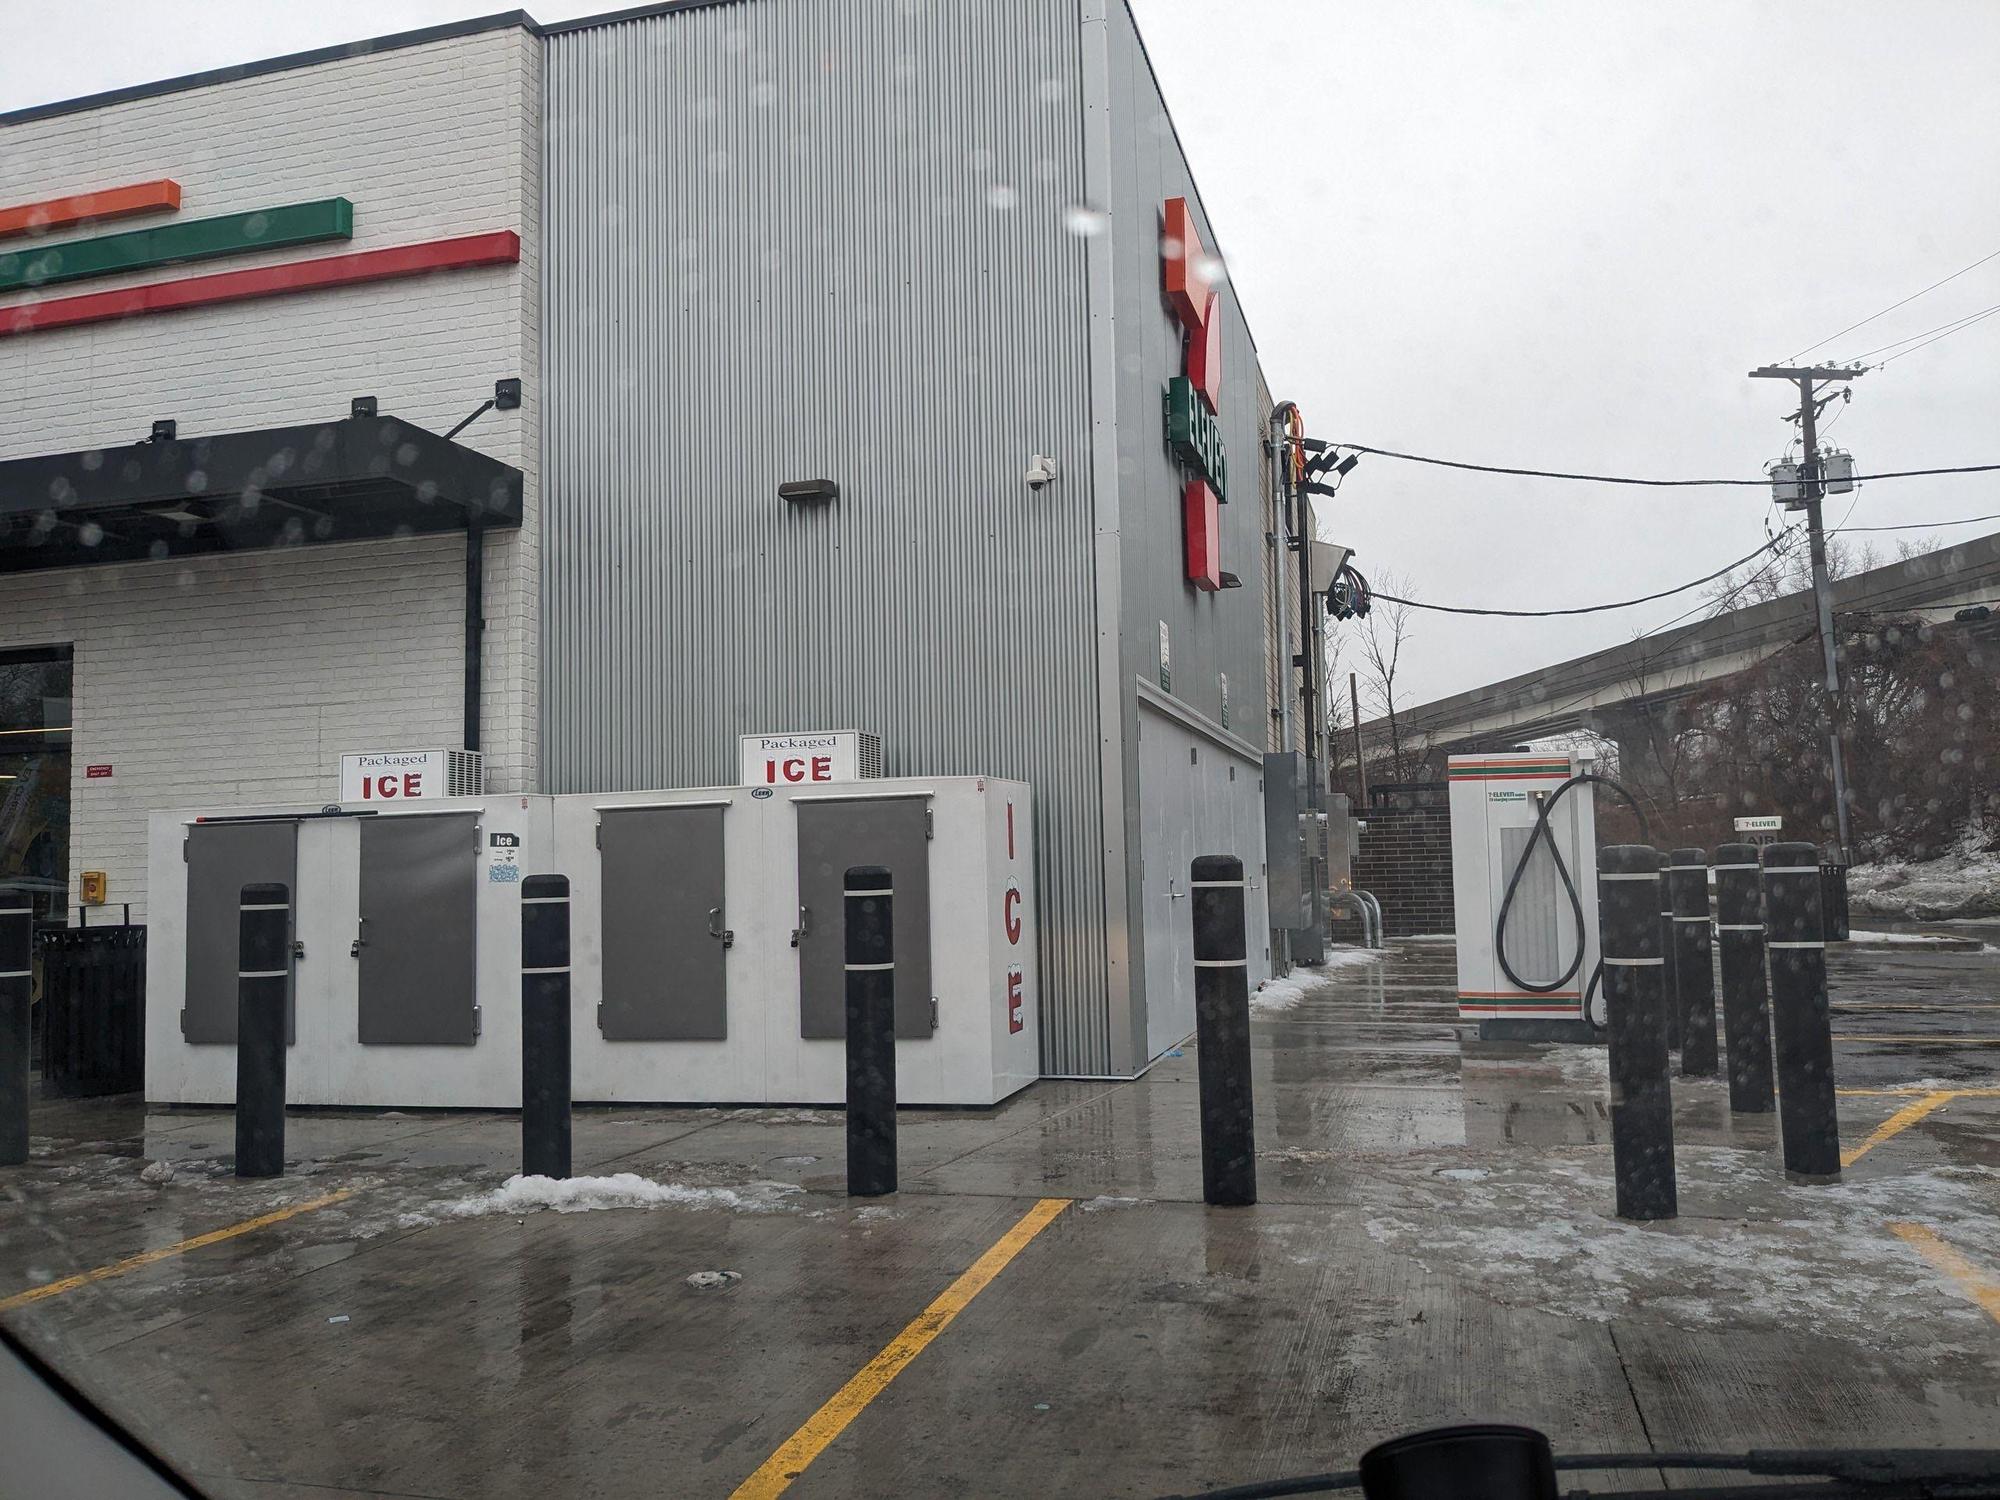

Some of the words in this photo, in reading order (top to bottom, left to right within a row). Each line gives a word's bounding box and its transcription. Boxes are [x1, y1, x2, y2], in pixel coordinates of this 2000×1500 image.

[760, 736, 836, 749] Packaged
[360, 753, 427, 766] Packaged
[766, 756, 832, 783] ICE
[363, 773, 422, 799] ICE
[496, 834, 513, 846] Ice
[1004, 793, 1024, 1035] ICE
